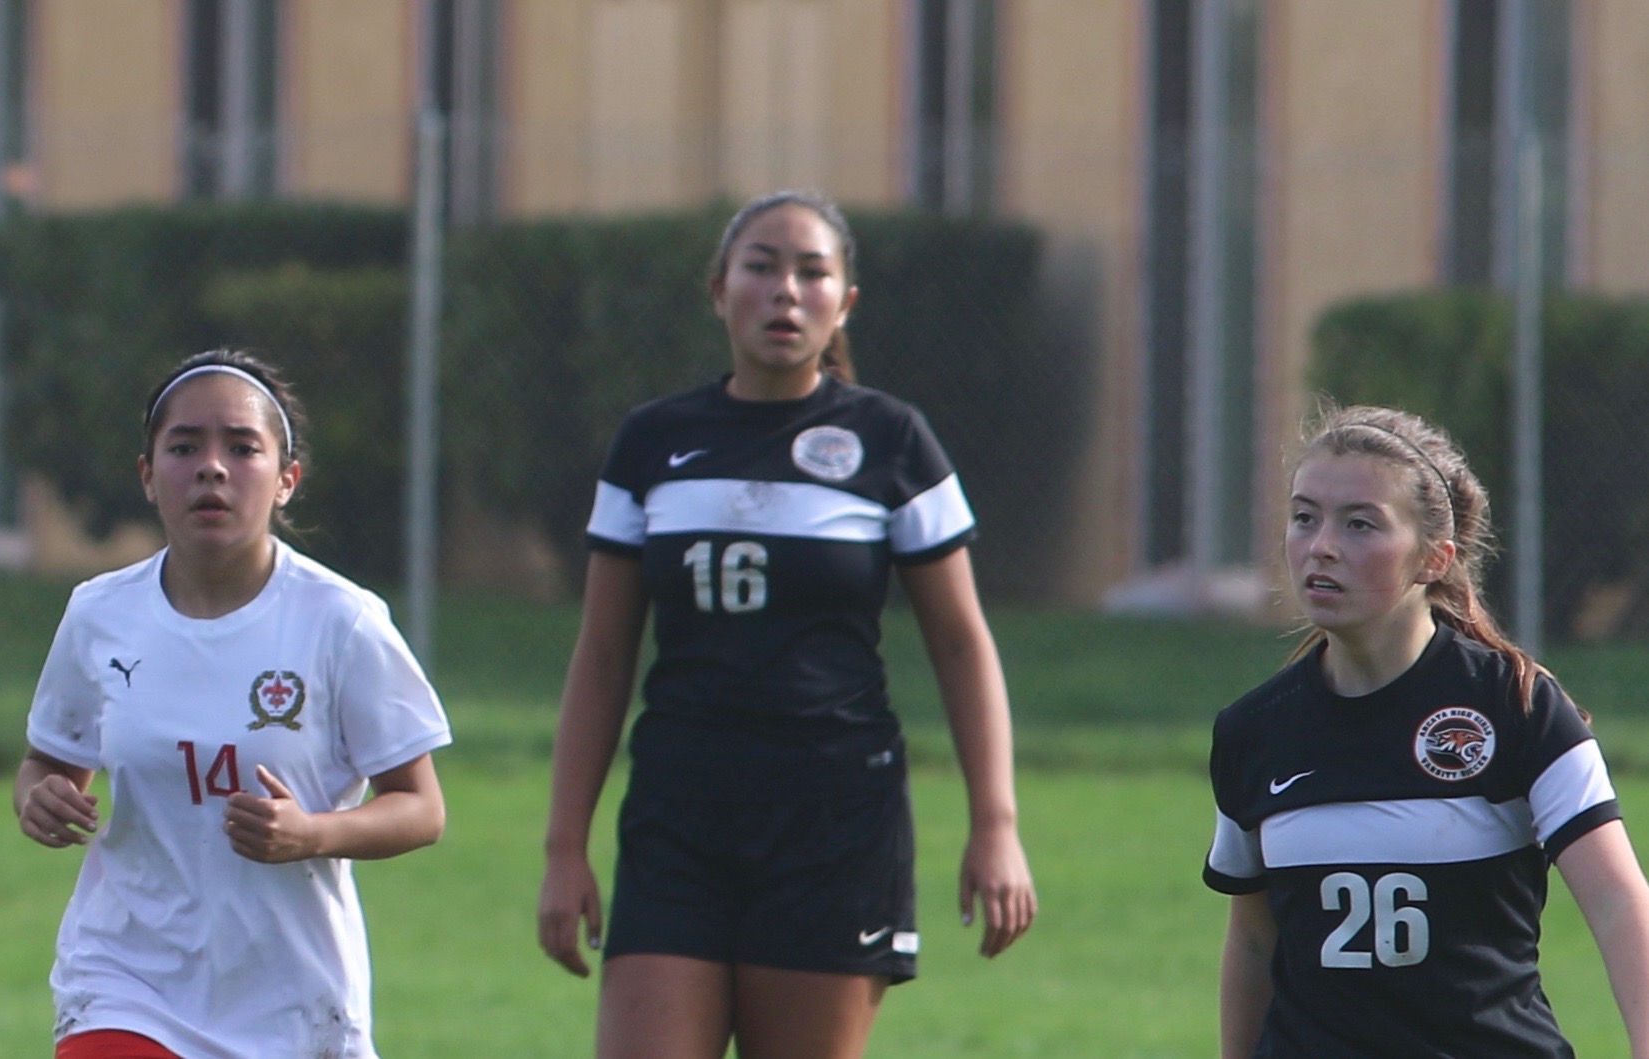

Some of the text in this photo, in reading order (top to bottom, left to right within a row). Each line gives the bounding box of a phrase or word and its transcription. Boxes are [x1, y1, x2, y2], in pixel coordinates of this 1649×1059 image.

[683, 541, 768, 612] 16
[1450, 709, 1473, 717] HIGH
[177, 741, 247, 805] 14
[1420, 756, 1457, 778] VARSITY
[1320, 872, 1429, 969] 26
